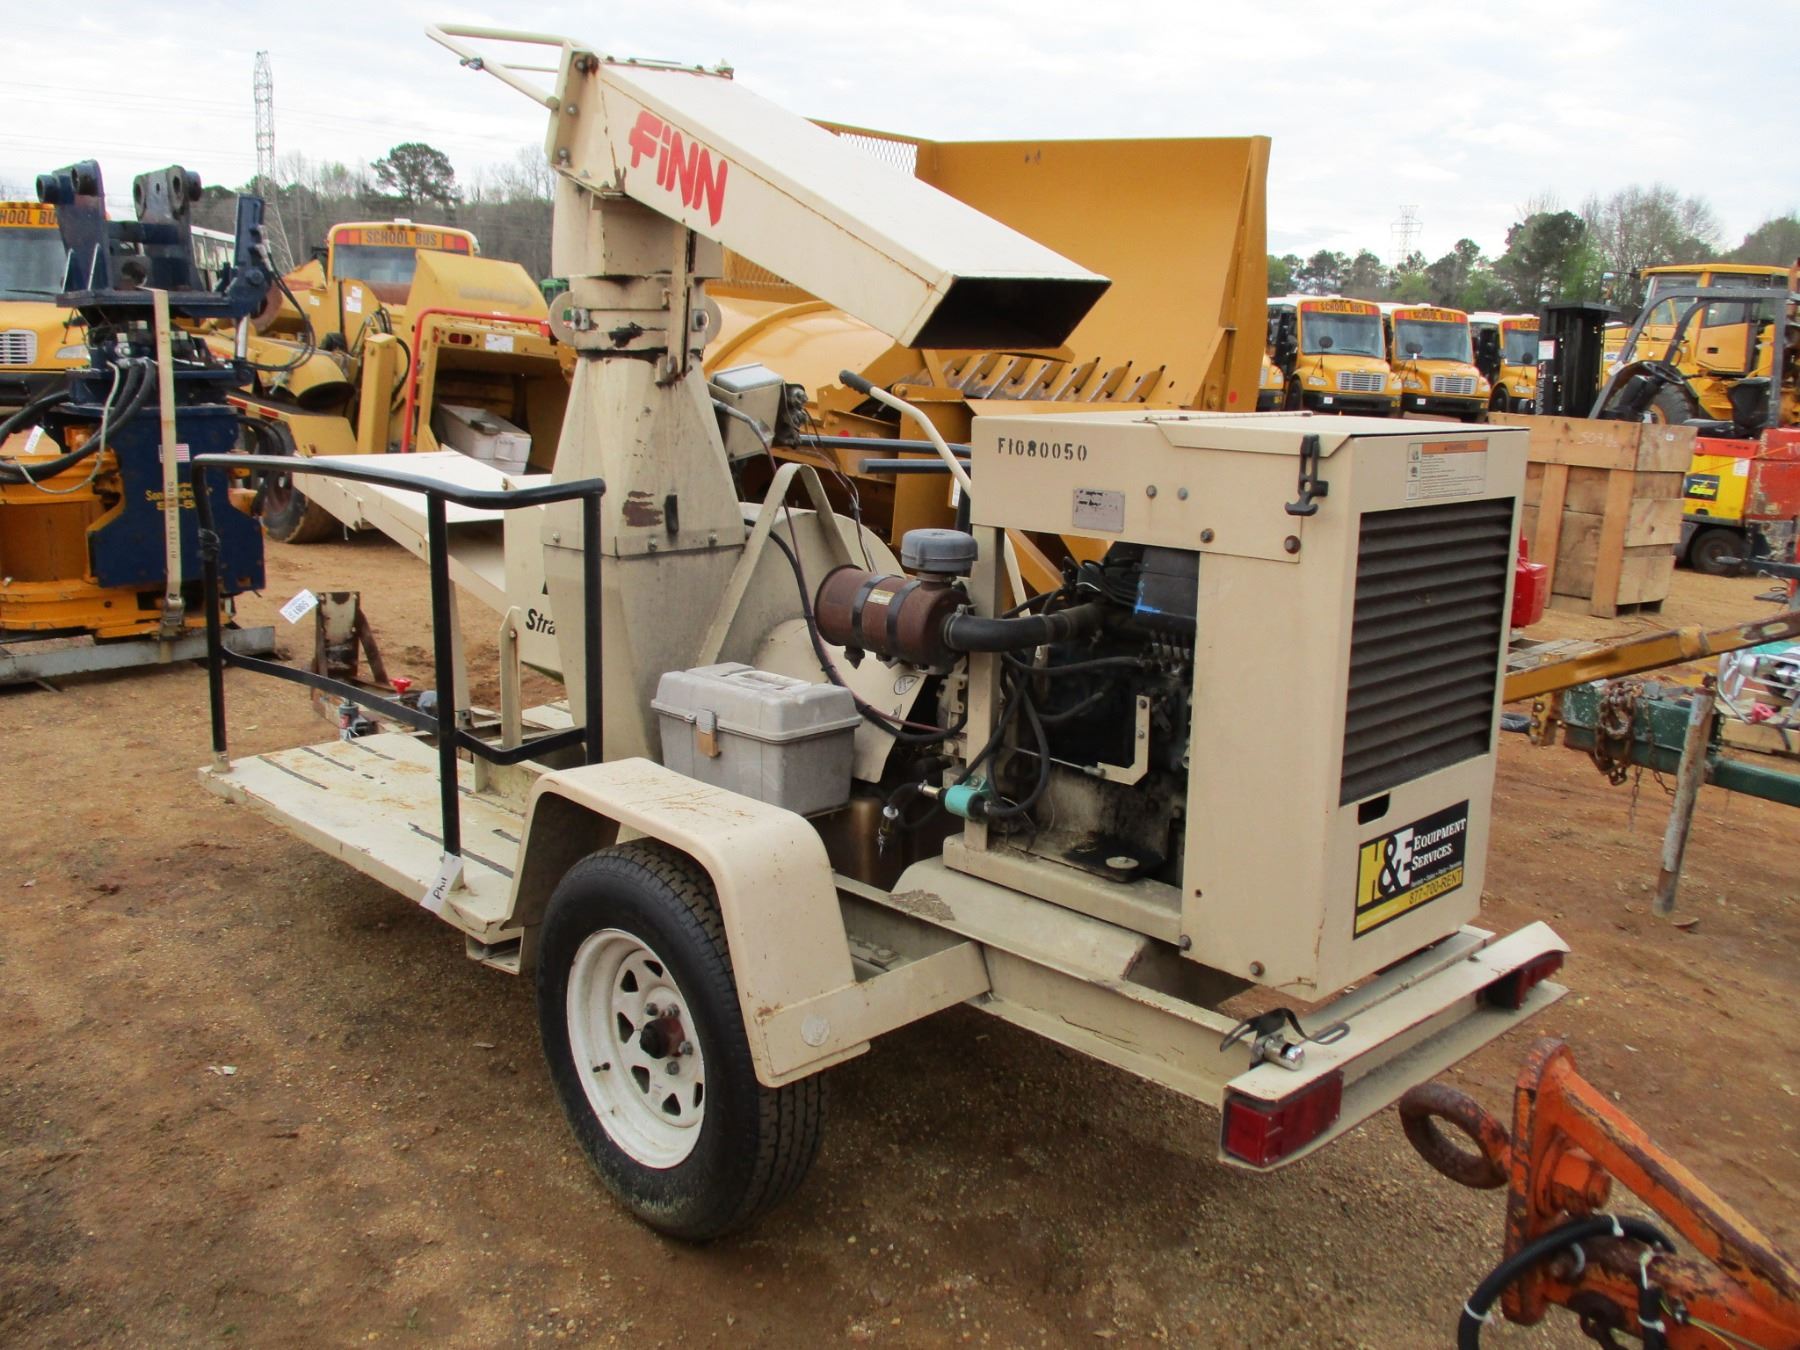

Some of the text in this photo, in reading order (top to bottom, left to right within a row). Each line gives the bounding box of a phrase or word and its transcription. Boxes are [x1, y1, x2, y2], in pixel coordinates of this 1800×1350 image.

[367, 230, 438, 246] SCHOOL BUS
[1320, 301, 1364, 313] SCHOOL BUS
[1413, 310, 1453, 321] SCHOOL BUS
[1412, 818, 1467, 852] EQUIPMENT
[1411, 843, 1453, 871] SERVICES
